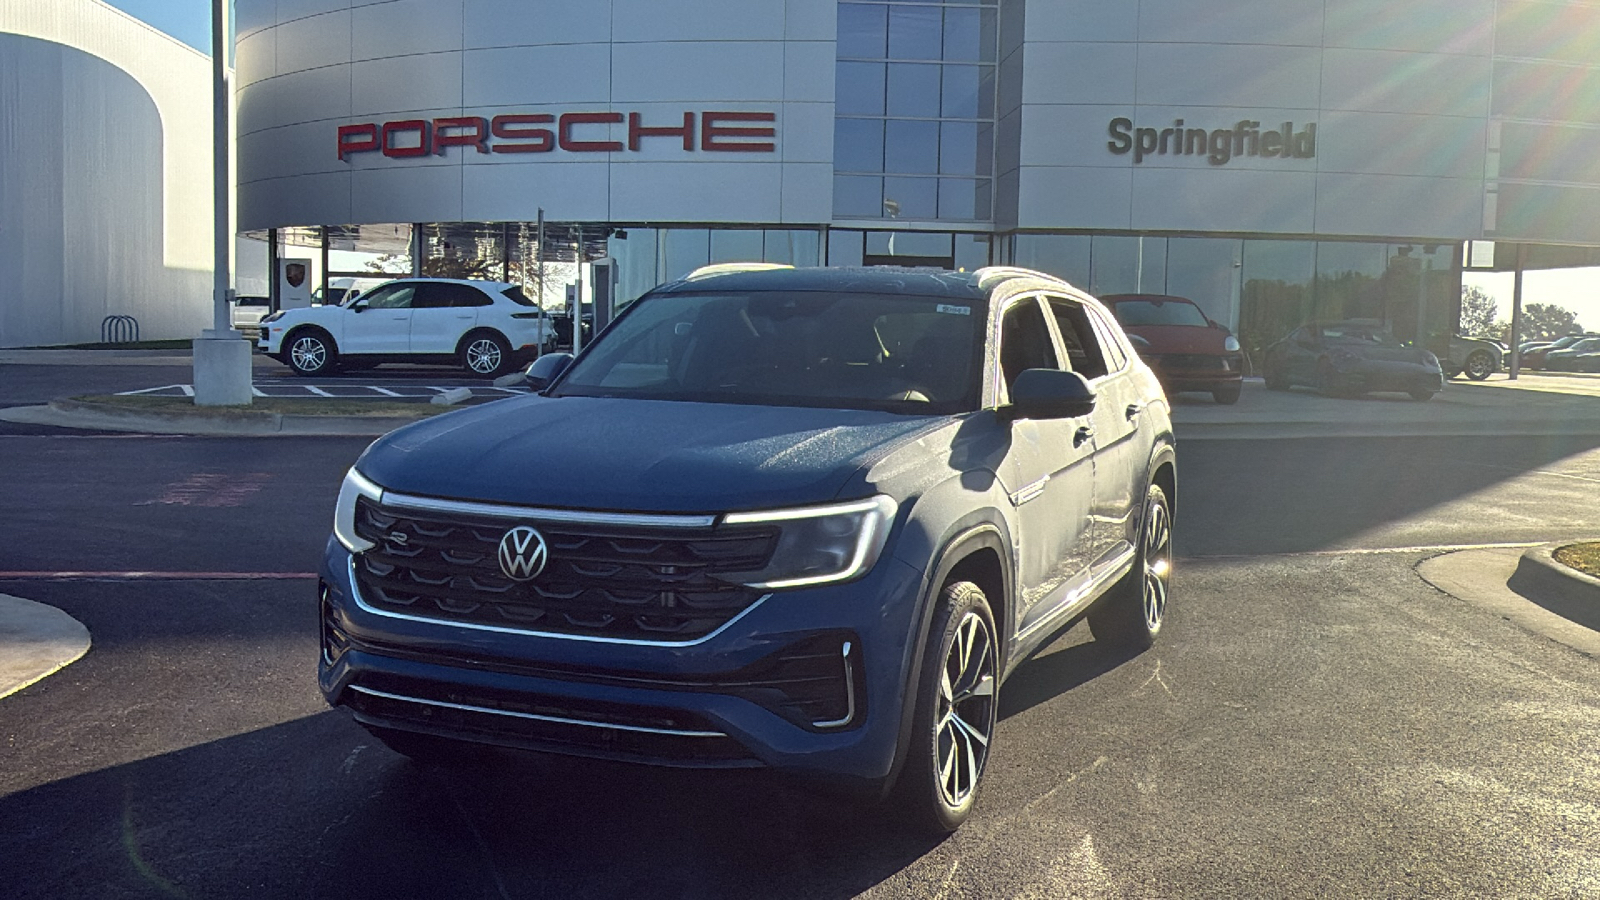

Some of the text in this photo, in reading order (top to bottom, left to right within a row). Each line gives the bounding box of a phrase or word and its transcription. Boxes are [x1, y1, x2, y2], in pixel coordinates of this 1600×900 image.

[338, 112, 776, 162] PORSCHE
[1108, 117, 1317, 165] Springfield
[499, 526, 547, 581] VW
